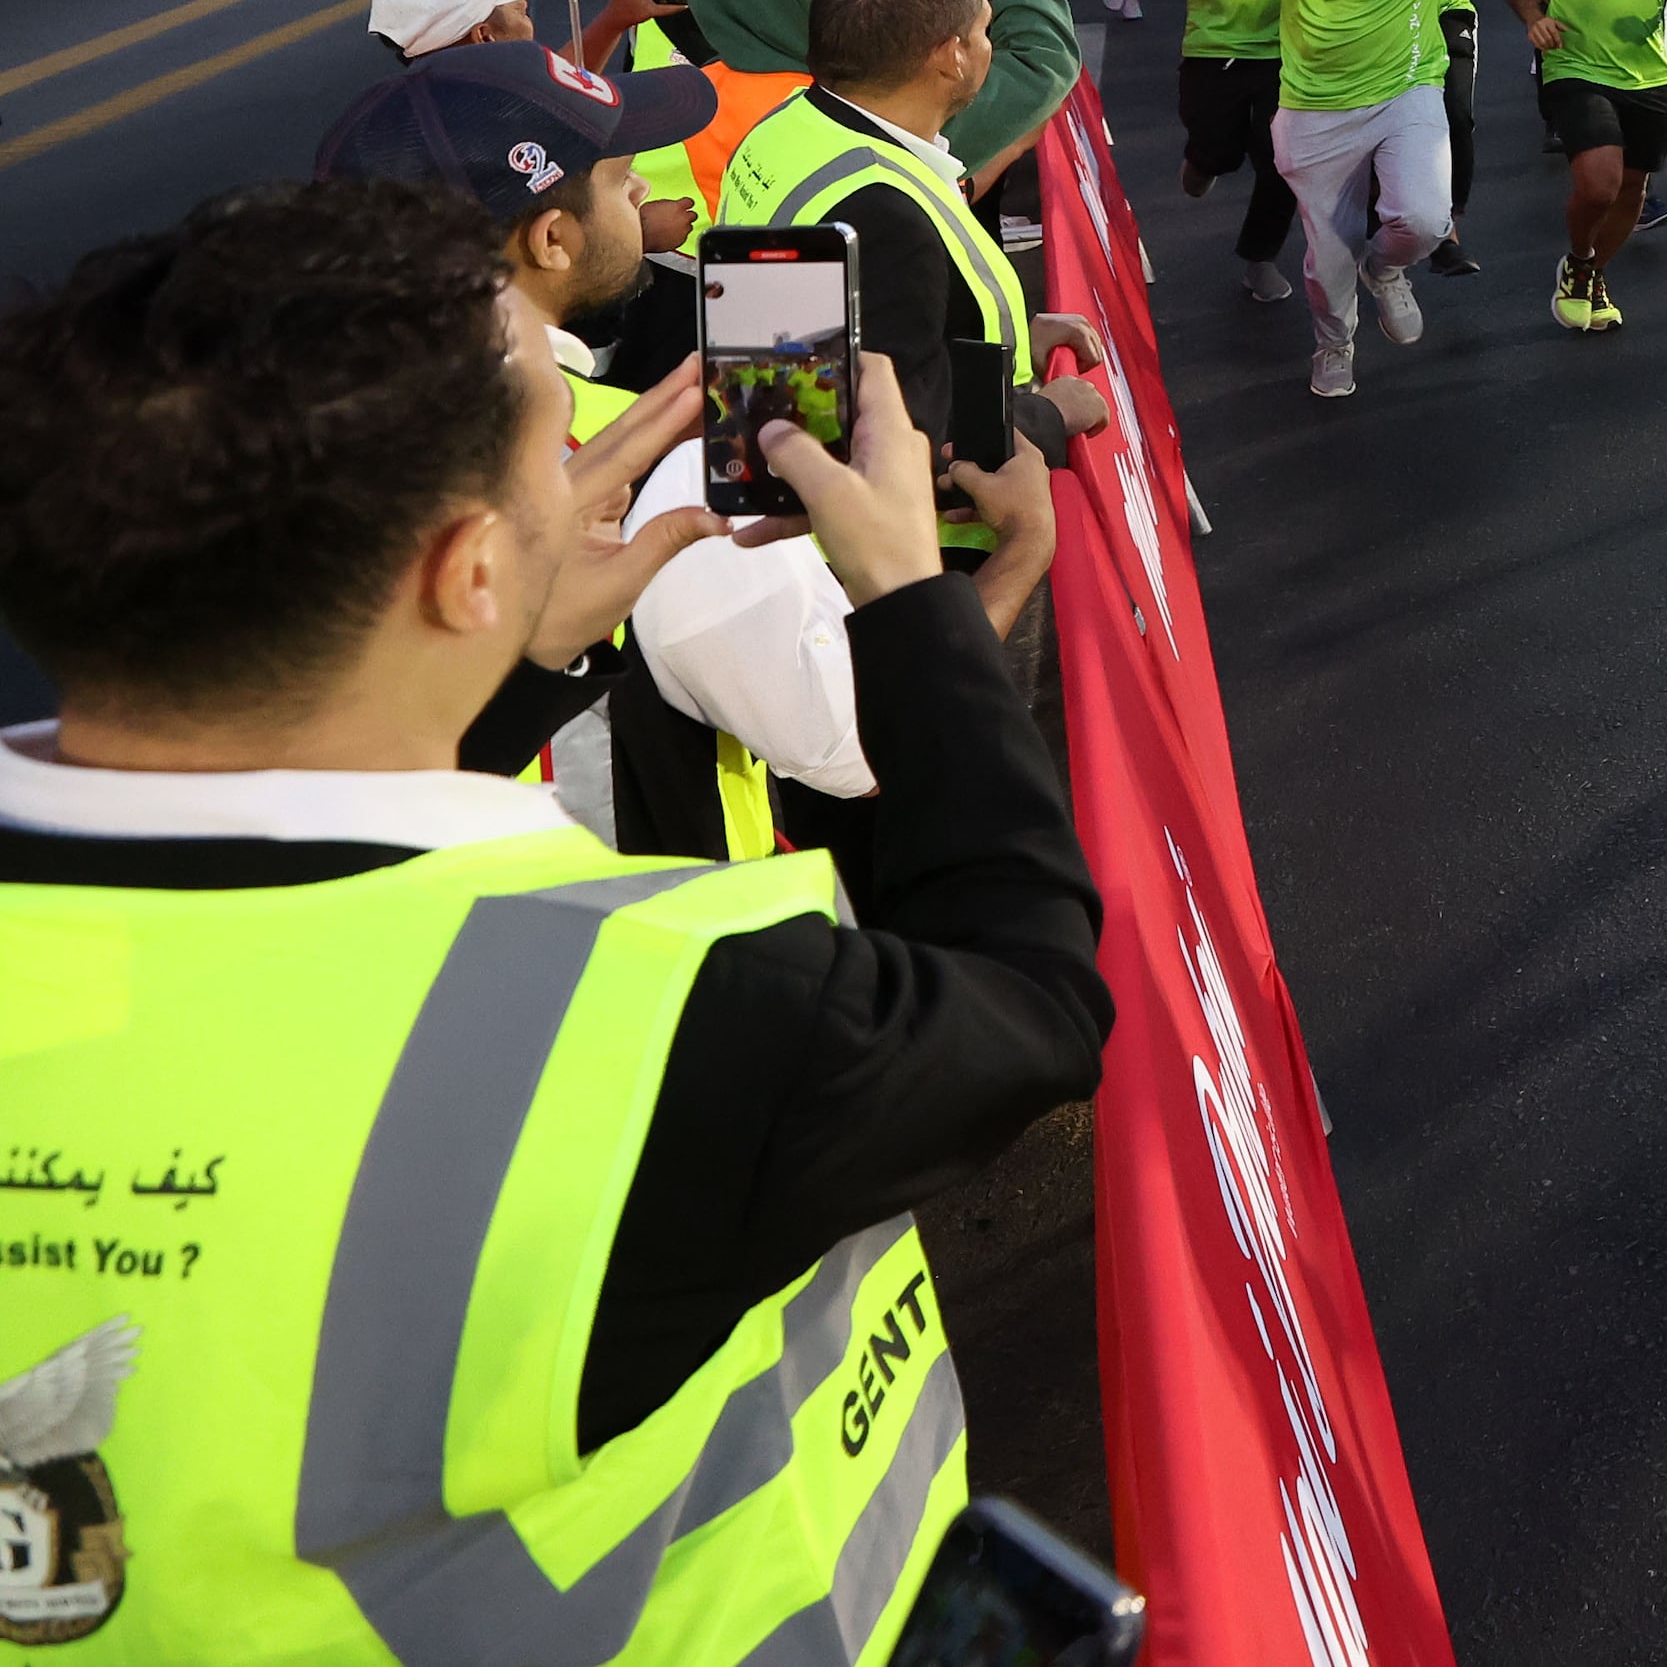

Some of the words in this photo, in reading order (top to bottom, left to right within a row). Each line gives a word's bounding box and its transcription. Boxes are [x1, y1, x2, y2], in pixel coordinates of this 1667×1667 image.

[131, 1148, 226, 1212] كيف
[93, 1237, 165, 1277] You
[180, 1242, 201, 1280] ?
[841, 1270, 926, 1460] GENT
